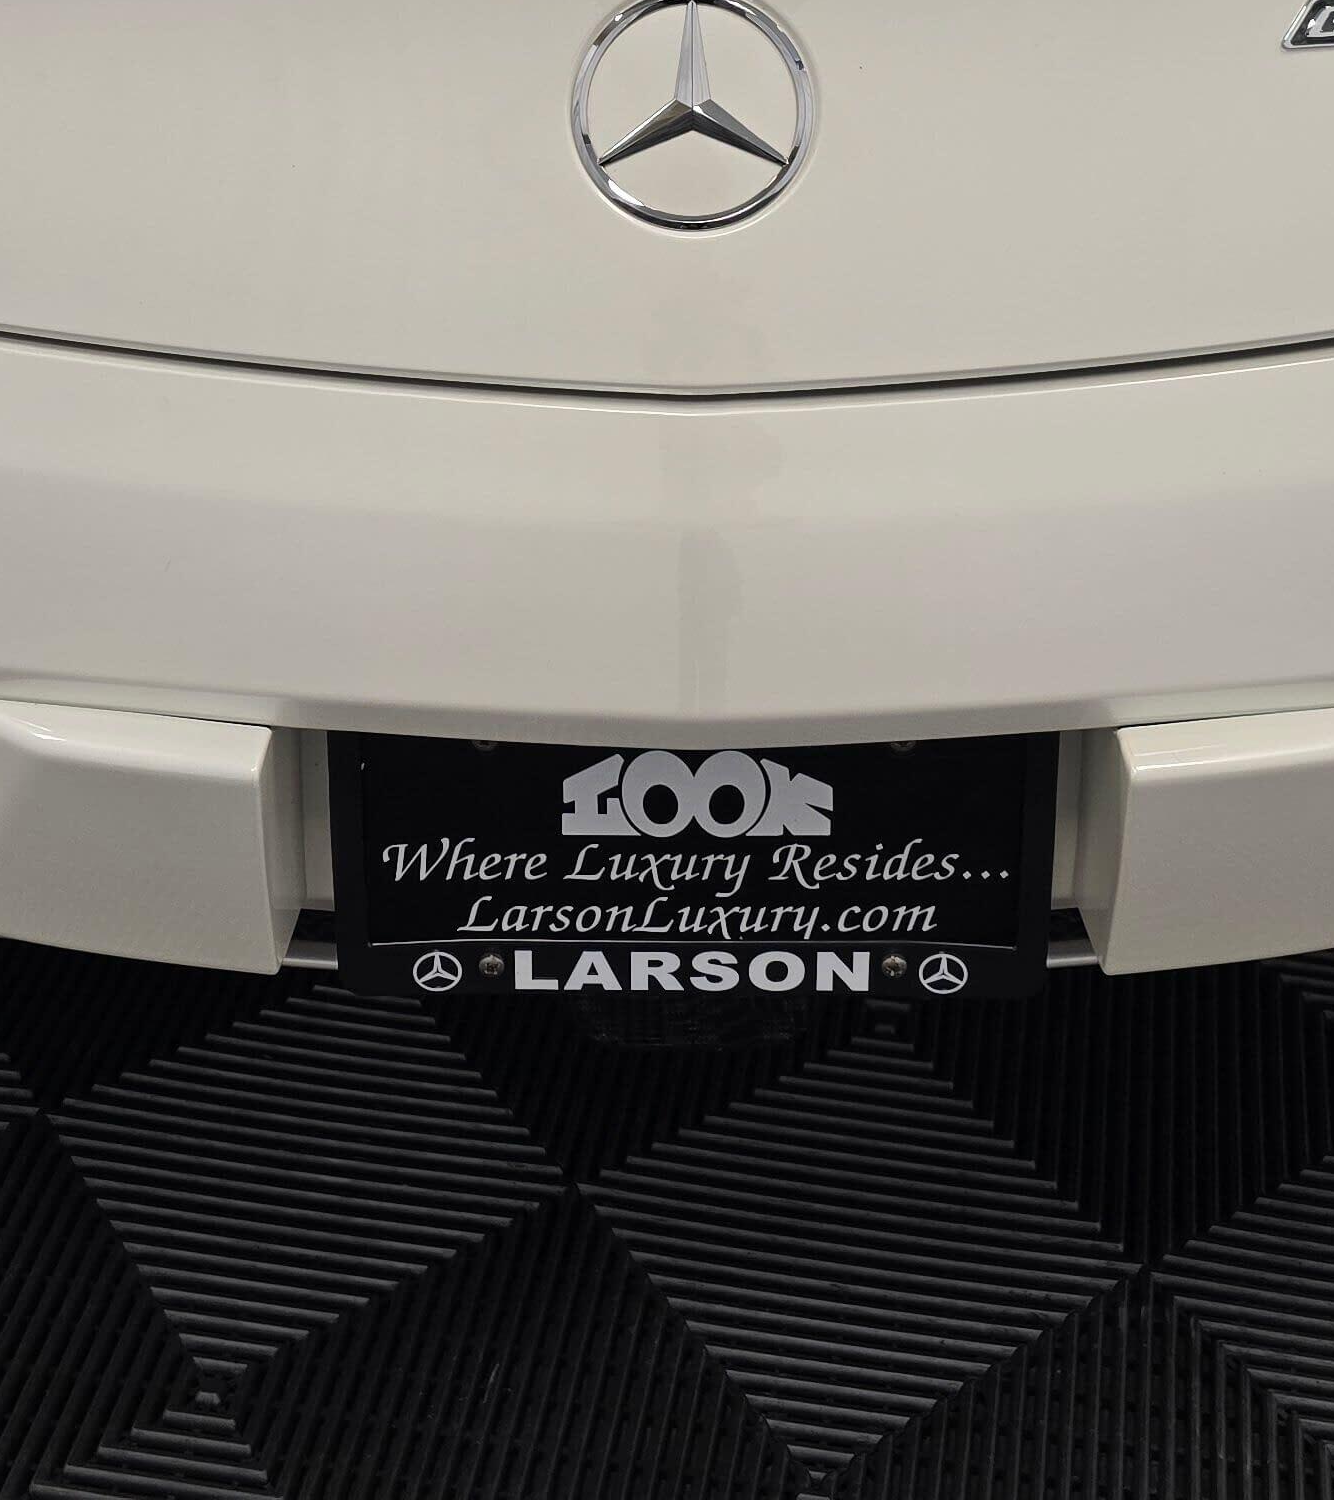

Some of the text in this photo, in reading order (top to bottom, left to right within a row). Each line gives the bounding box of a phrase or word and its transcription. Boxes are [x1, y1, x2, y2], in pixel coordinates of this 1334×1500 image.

[562, 750, 834, 838] LOOK
[382, 837, 1010, 898] Where Luxury Resides...
[456, 895, 938, 940] LarsonLuxury.com
[514, 949, 871, 992] LARSON
